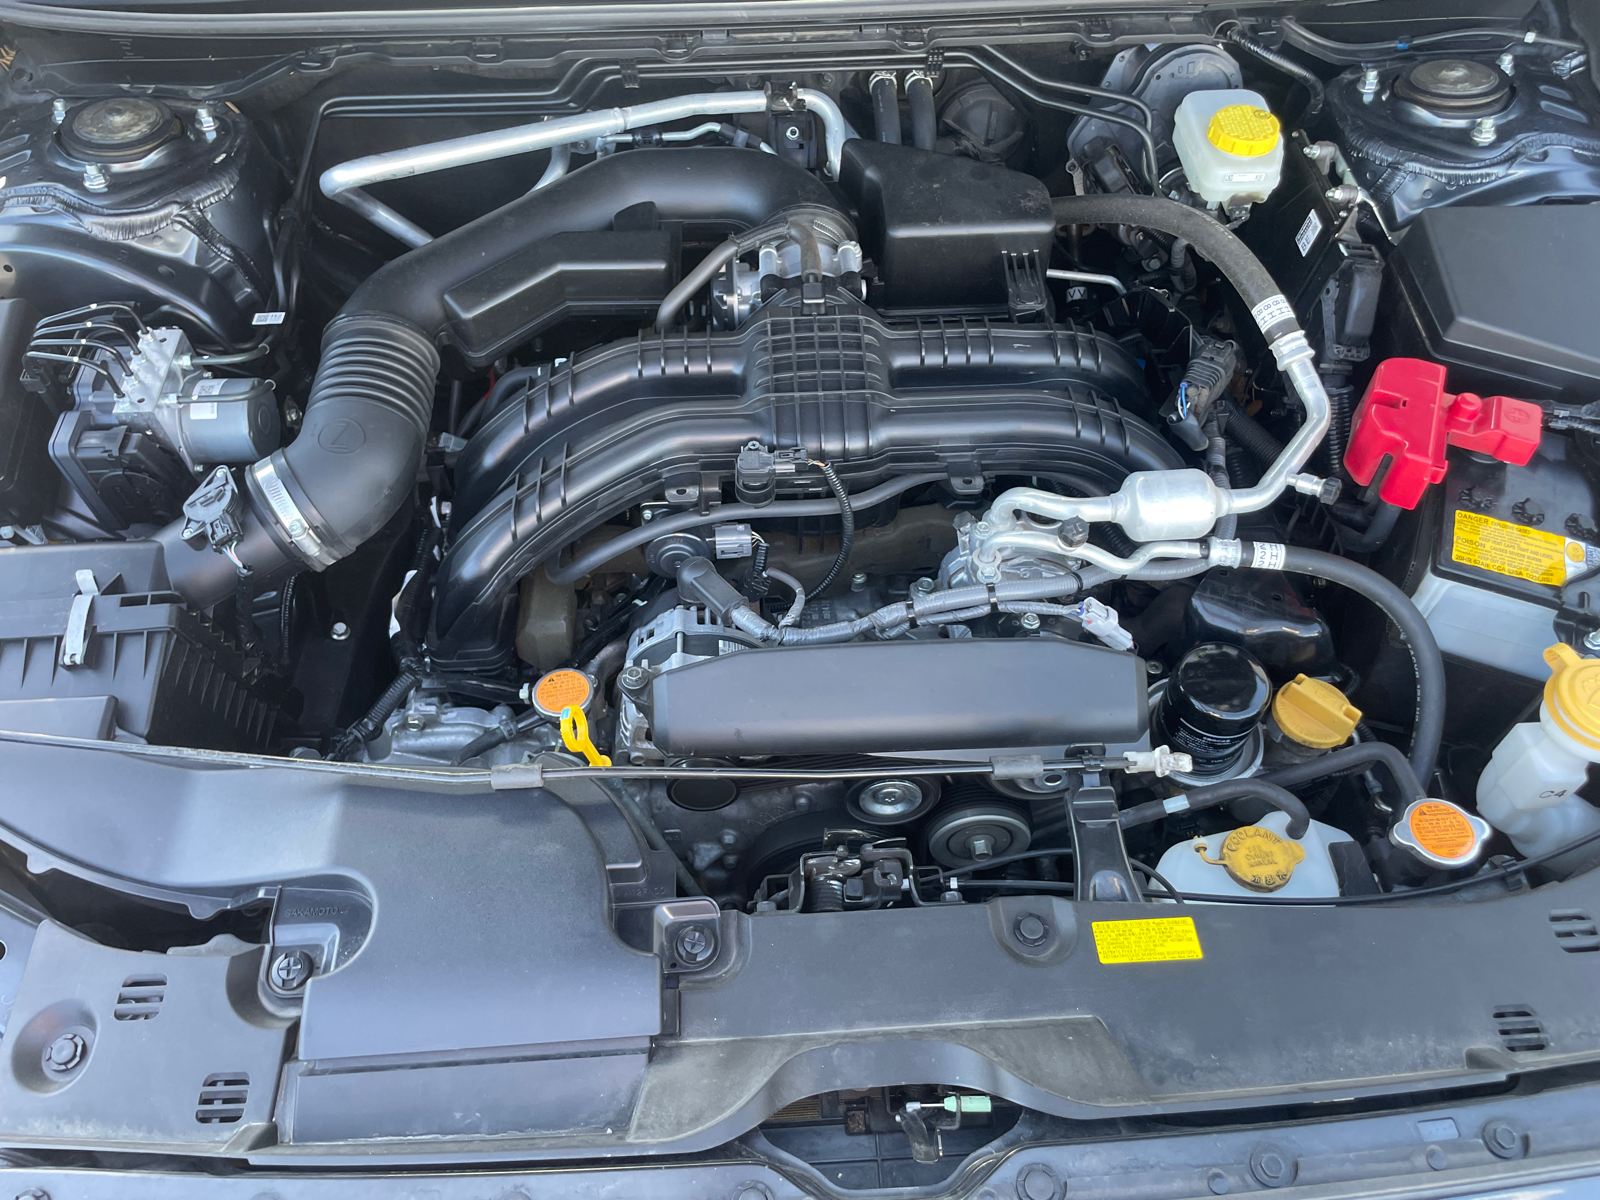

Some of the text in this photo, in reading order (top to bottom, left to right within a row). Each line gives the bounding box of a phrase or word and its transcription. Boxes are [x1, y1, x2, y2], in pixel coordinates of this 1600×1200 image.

[1457, 512, 1489, 525] DANGER
[1456, 536, 1542, 563] POISON CAUSES SEVERE BURNS
[1479, 536, 1491, 544] KEEP
[1491, 539, 1503, 547] VENT
[1503, 542, 1516, 550] CAPS
[1516, 545, 1529, 553] TIGHT
[1540, 552, 1554, 560] LEVEL
[1455, 554, 1472, 564] 20HR
[1492, 564, 1506, 573] CCA
[1478, 555, 1489, 563] KEEP
[1506, 561, 1523, 570] REACH
[1530, 567, 1554, 577] CHILDREN
[1539, 790, 1567, 798] C4
[1226, 828, 1282, 852] COOLANT
[284, 907, 340, 917] SAKAMOTO
